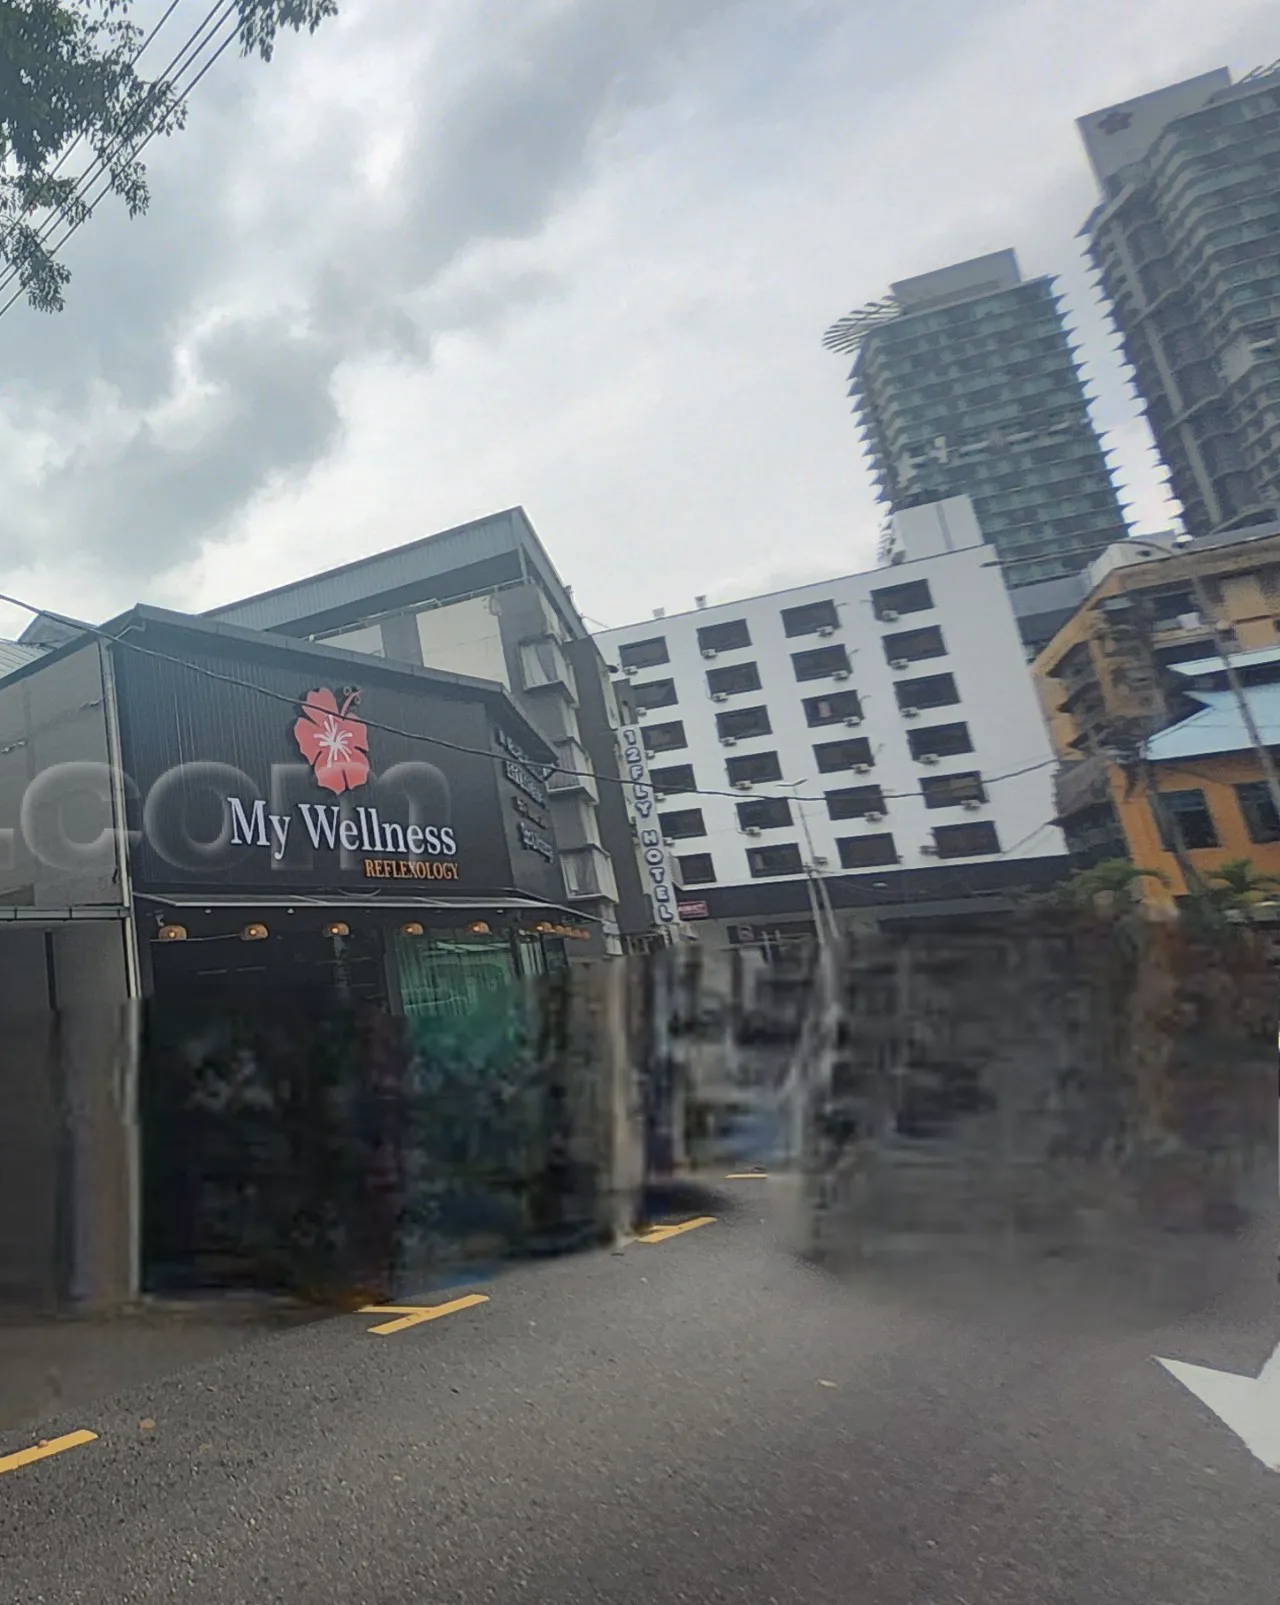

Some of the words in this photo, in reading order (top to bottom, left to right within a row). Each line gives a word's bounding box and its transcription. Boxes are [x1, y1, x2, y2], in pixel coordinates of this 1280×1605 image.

[227, 797, 291, 860] My
[298, 803, 457, 855] Wellness
[624, 729, 652, 819] 12FLY
[641, 829, 674, 923] HOTEL
[363, 858, 459, 880] REFLEXOLOGY
